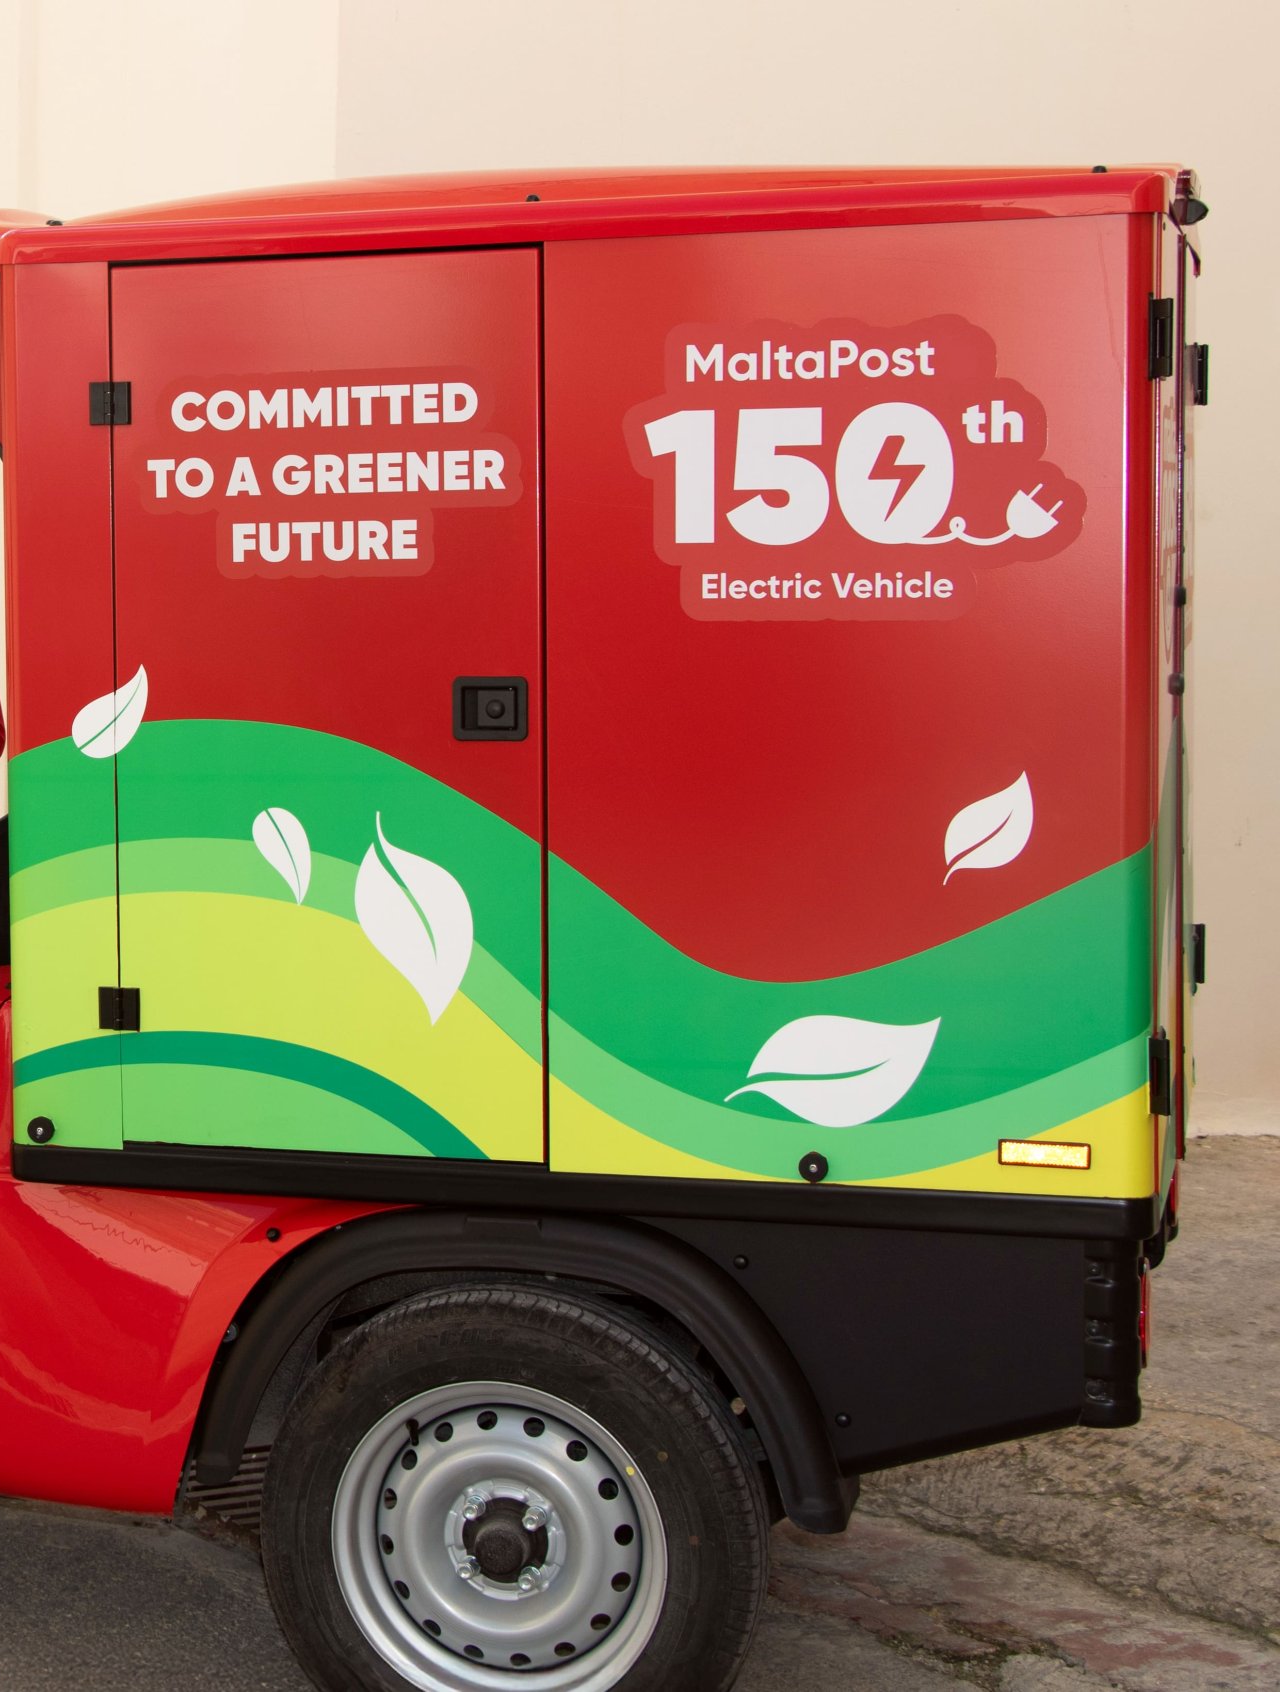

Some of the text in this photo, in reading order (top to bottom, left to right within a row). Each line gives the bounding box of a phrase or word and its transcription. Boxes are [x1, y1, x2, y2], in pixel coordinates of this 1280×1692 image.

[686, 339, 935, 383] MaltaPost
[171, 382, 479, 433] COMMITTED
[147, 449, 506, 498] TO A GREENER
[232, 519, 418, 563] FUTURE
[702, 571, 954, 600] Electric Vehicle
